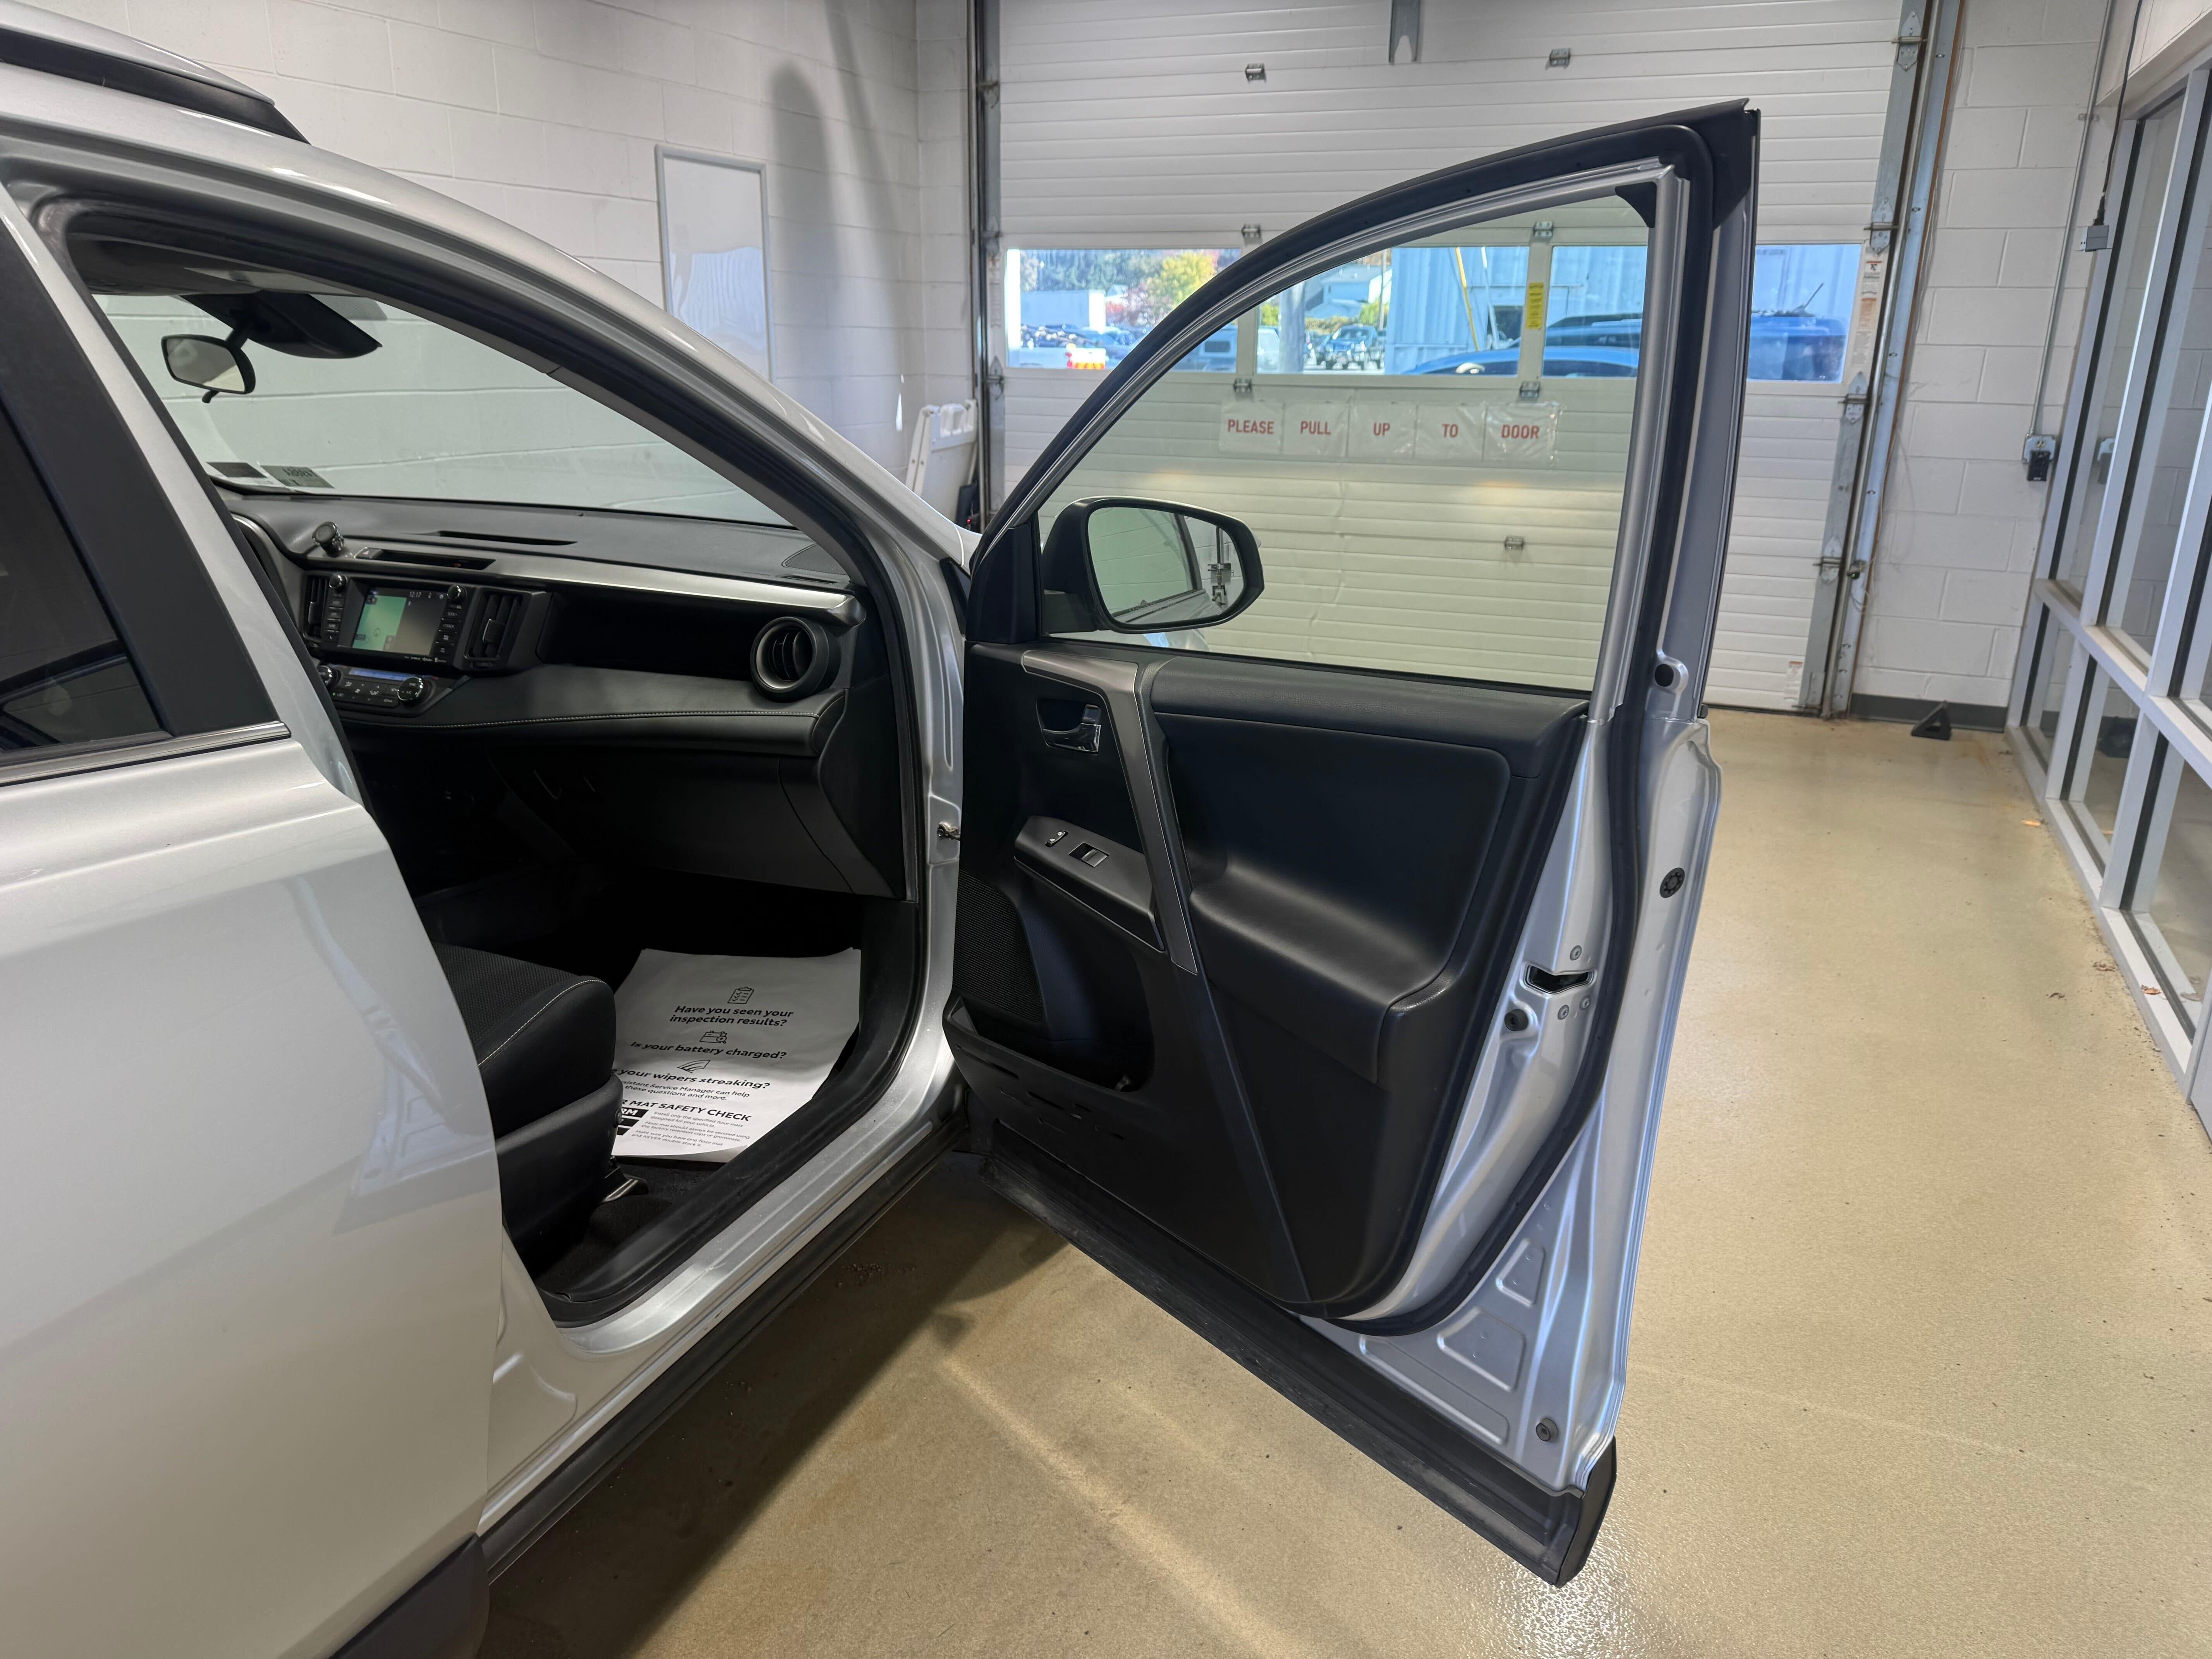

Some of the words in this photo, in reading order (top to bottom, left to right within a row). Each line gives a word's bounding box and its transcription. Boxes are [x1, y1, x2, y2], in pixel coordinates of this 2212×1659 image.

[1227, 419, 1274, 434] PLEASE
[1300, 421, 1331, 435] PULL
[1373, 422, 1390, 436] UP
[1442, 423, 1458, 438] TO
[1501, 424, 1539, 440] DOOR
[670, 1015, 735, 1024] inspection
[737, 1018, 787, 1027] results?
[675, 1044, 723, 1055] battery
[726, 1049, 787, 1059] charged?
[653, 1073, 697, 1082] wipers
[699, 1078, 771, 1089] streaking?
[658, 1103, 706, 1113] SAFETY
[708, 1109, 752, 1121] CHECK
